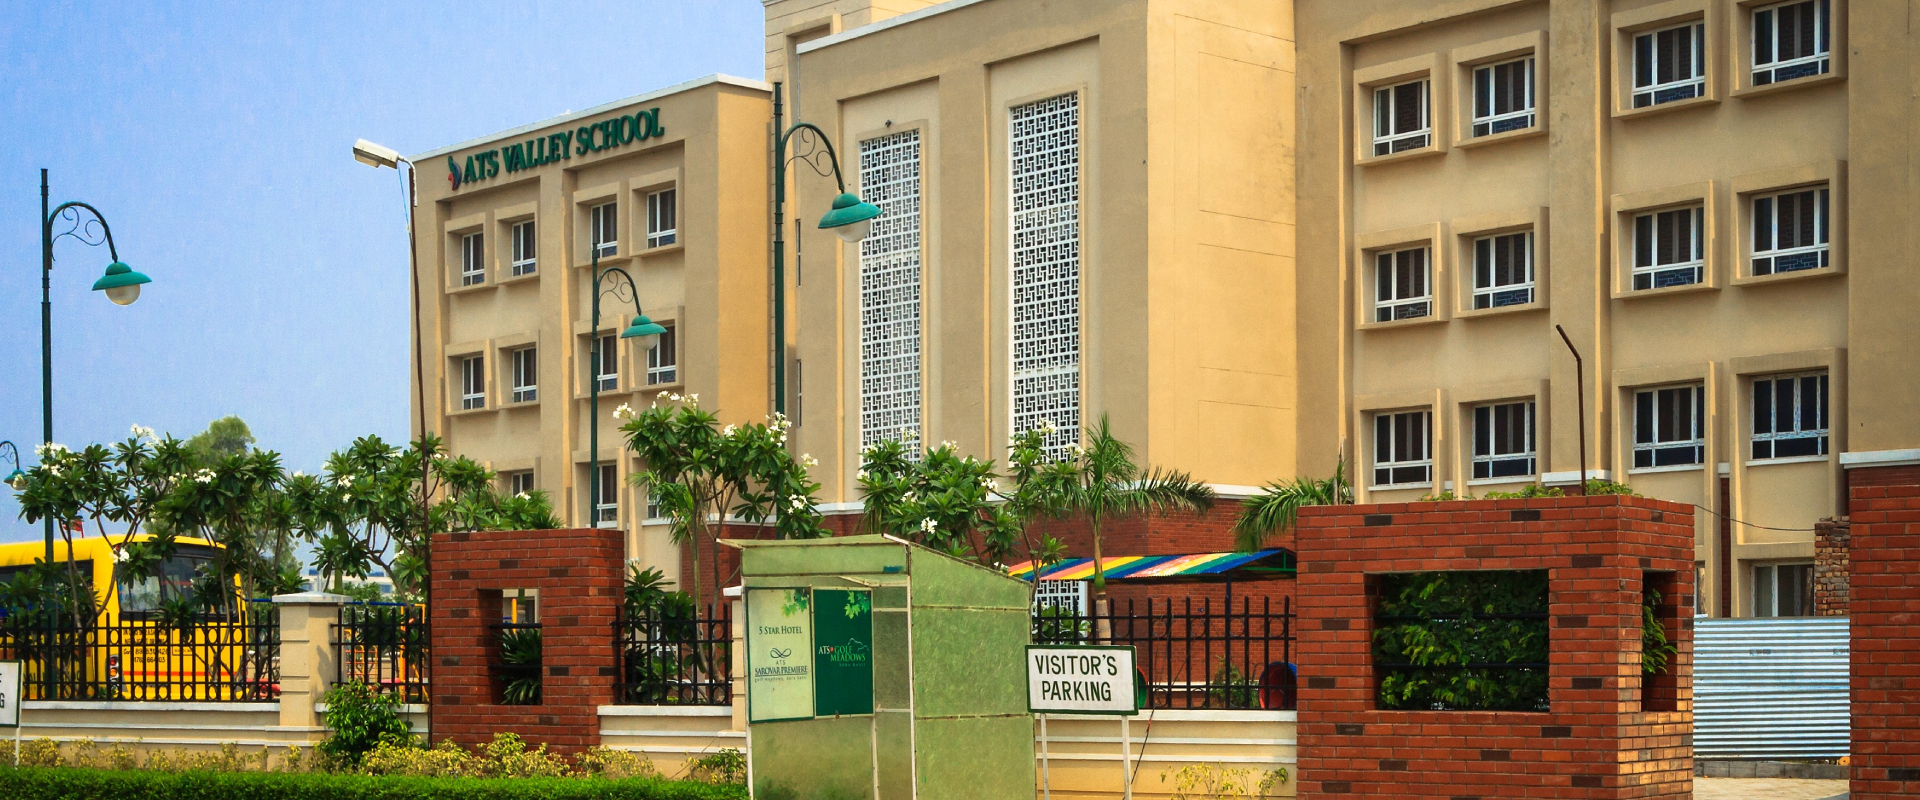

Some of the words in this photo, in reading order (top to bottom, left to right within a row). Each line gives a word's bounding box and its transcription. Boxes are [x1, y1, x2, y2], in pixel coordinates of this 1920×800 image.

[462, 150, 499, 183] ATS
[501, 130, 574, 173] VALLEY
[576, 107, 665, 156] SCHOOL
[759, 626, 763, 635] 5
[781, 625, 803, 634] HOTEL
[818, 645, 831, 654] ATS
[834, 645, 853, 654] GOLF
[830, 653, 866, 661] MEADOWS
[1035, 654, 1118, 676] VISITOR'S
[1042, 680, 1112, 702] PARKING
